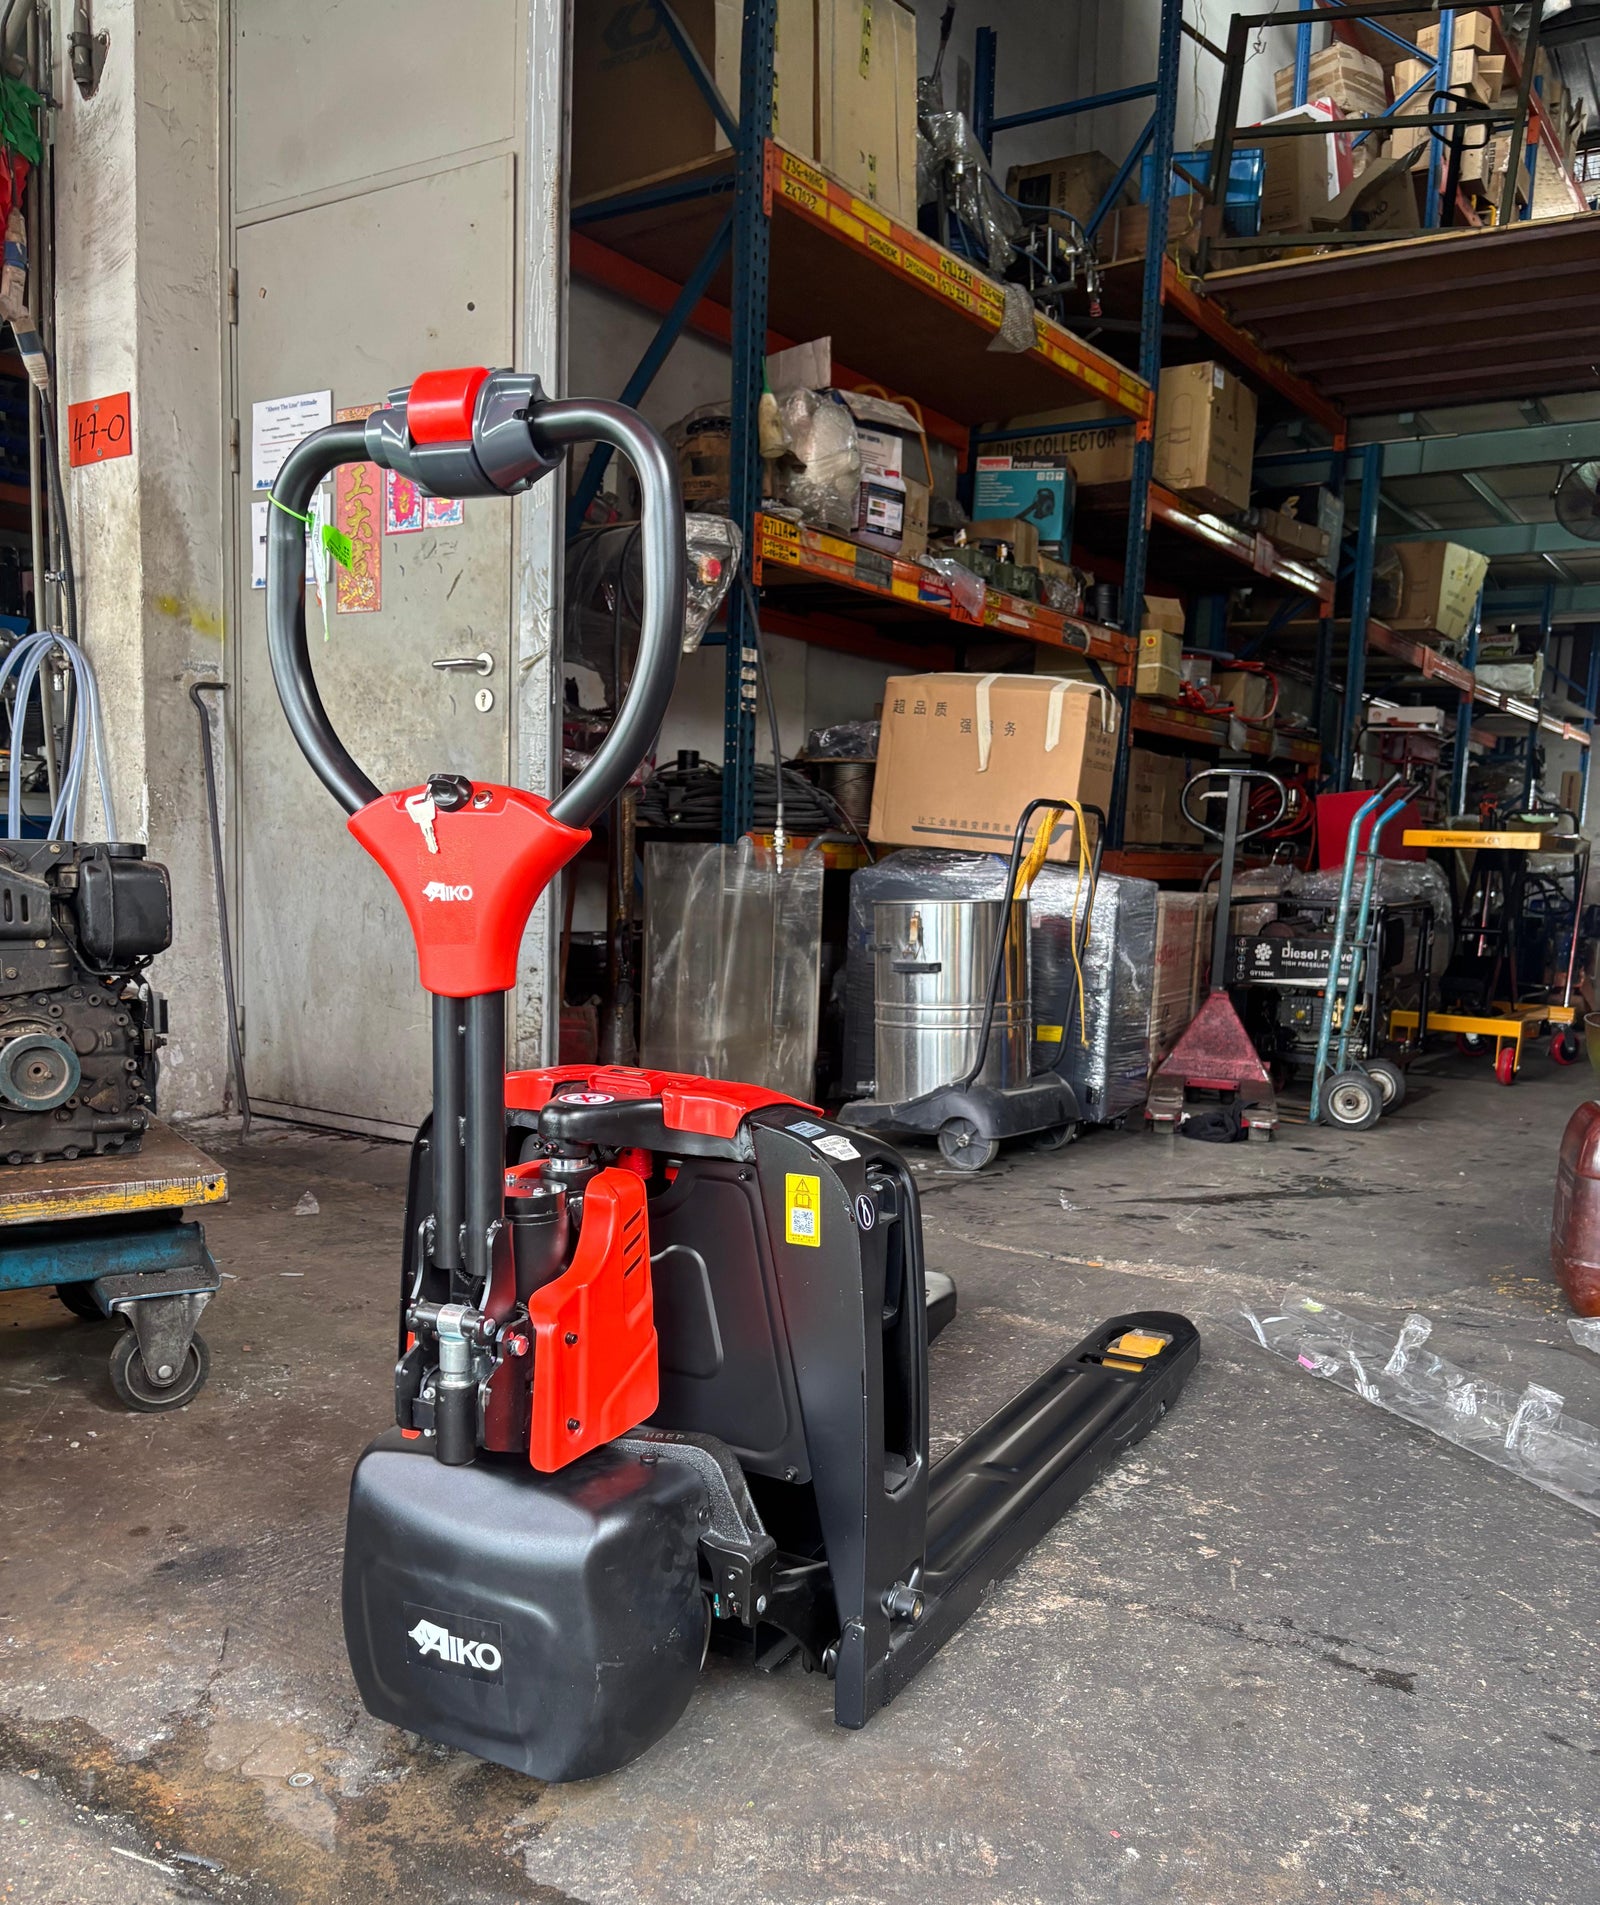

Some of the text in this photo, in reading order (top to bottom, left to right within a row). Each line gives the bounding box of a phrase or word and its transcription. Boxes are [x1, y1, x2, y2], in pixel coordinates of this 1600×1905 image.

[73, 413, 125, 452] 47-0
[1034, 428, 1117, 456] COLLECTOR
[421, 880, 474, 903] AIKO
[1281, 946, 1318, 960] Diesel
[1297, 961, 1329, 969] PRESSURE
[407, 1618, 502, 1671] AIKO
